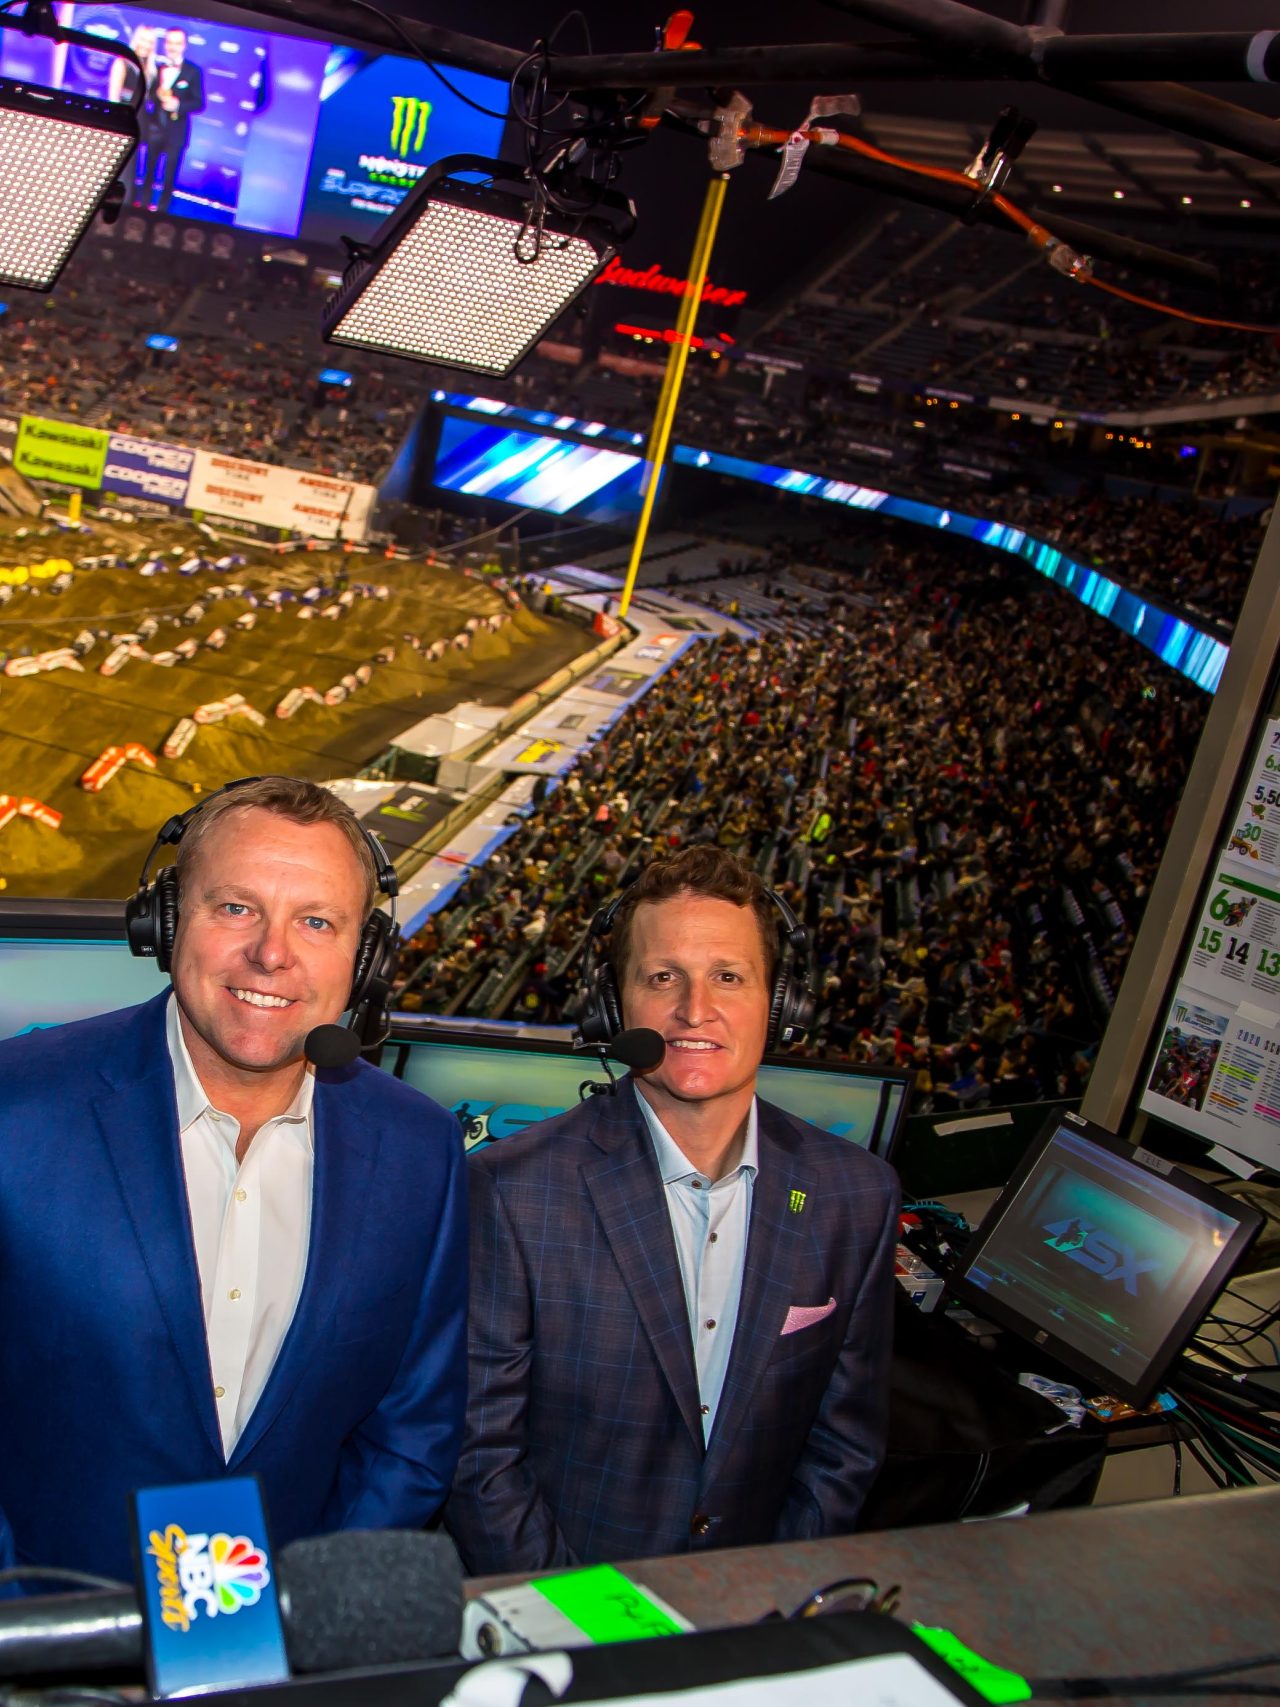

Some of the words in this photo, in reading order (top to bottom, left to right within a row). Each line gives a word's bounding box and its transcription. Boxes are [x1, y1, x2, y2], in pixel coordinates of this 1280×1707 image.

[24, 424, 104, 450] Kawasaki
[19, 451, 99, 476] Kawasaki
[1243, 822, 1262, 842] 30
[1210, 889, 1230, 921] 6
[1198, 926, 1223, 954] 15
[1225, 936, 1251, 965] 14
[1256, 948, 1280, 977] 13
[1237, 1029, 1261, 1048] 2020
[178, 1533, 219, 1621] NBC
